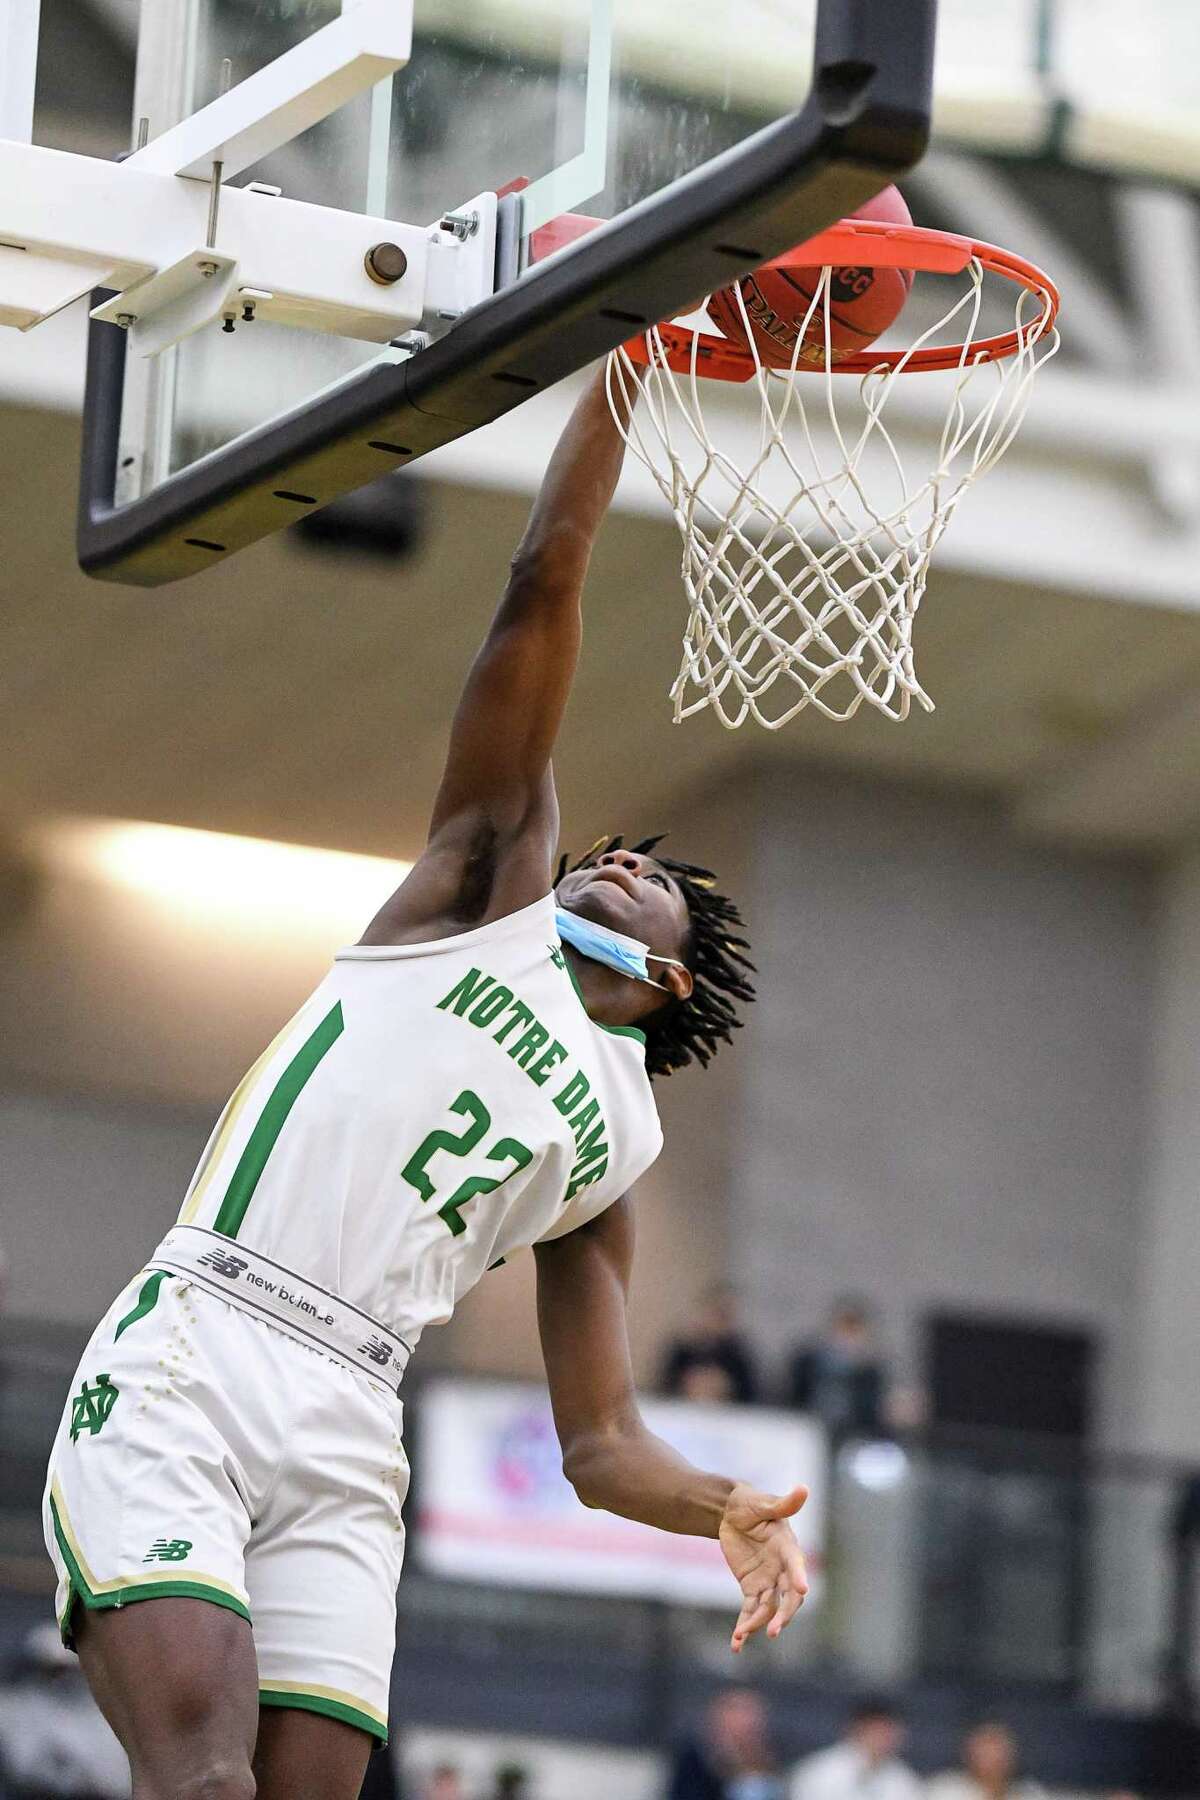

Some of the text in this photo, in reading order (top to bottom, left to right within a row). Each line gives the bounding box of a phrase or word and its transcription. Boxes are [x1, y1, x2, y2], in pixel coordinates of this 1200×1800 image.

[436, 967, 609, 1202] NOTRE DAME
[400, 1090, 534, 1237] 22
[246, 1272, 277, 1293] new
